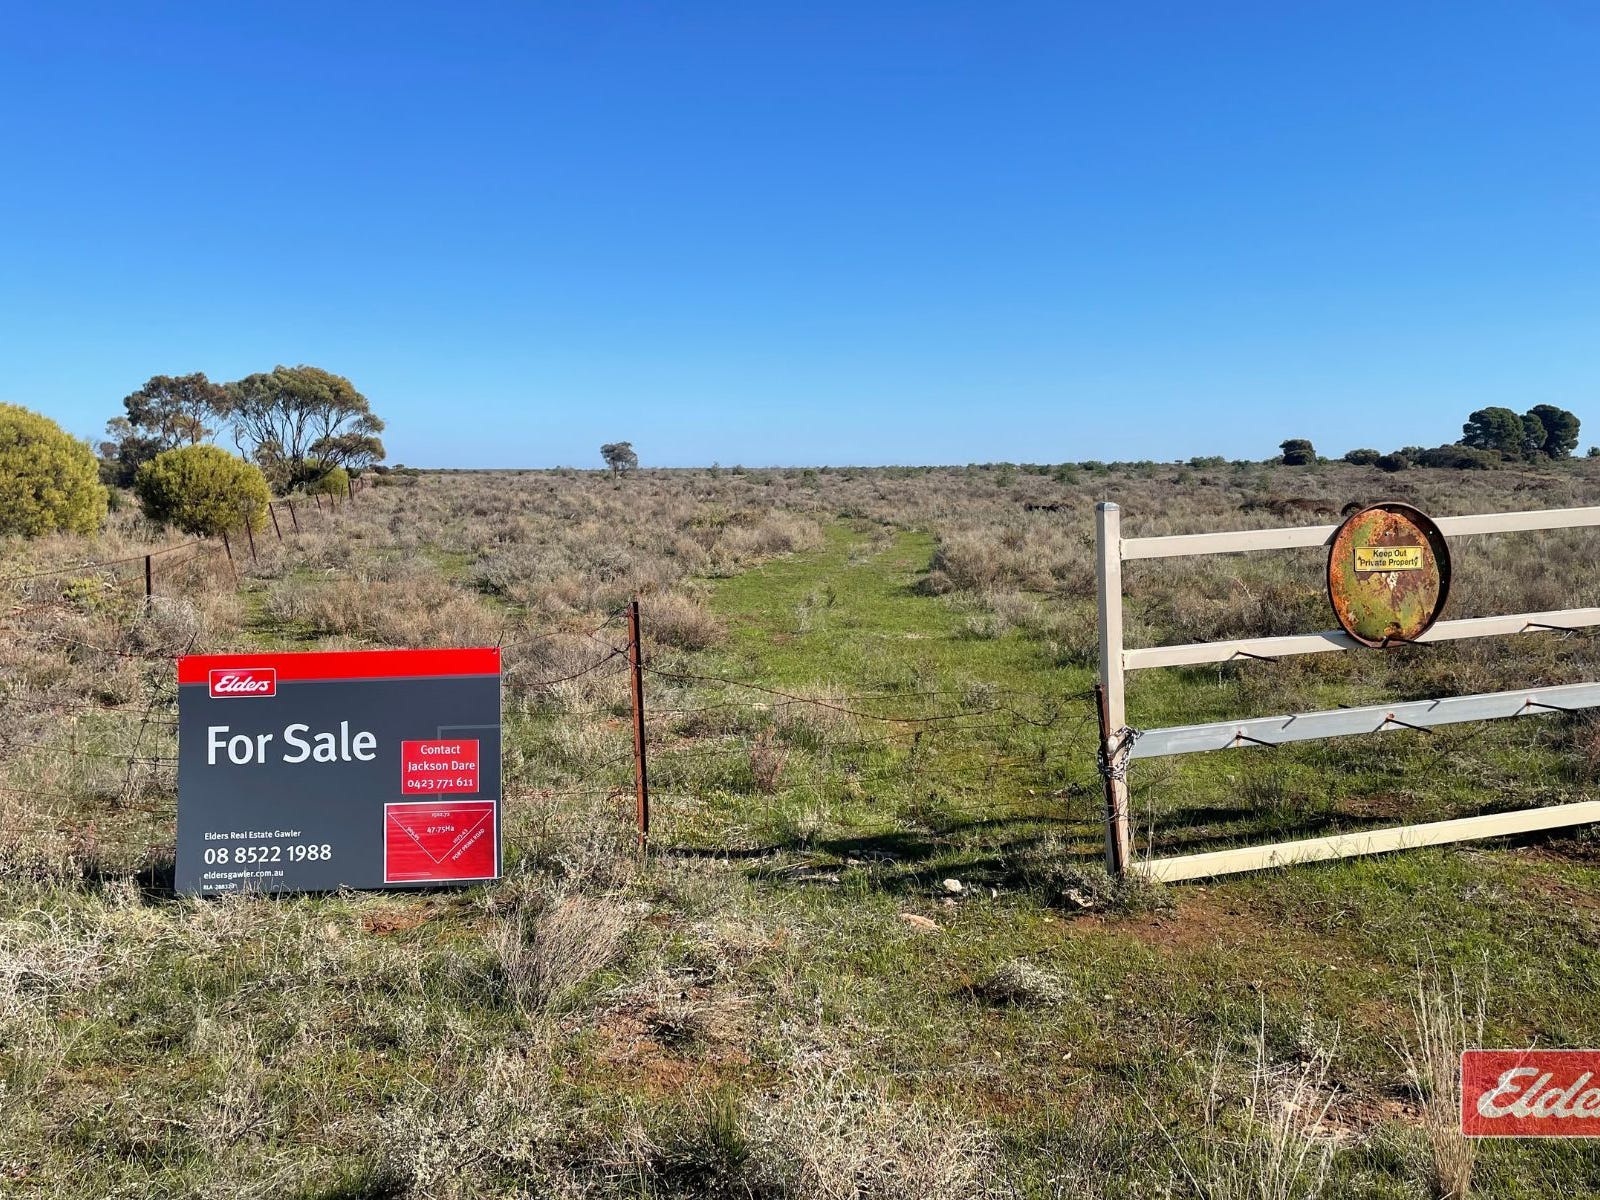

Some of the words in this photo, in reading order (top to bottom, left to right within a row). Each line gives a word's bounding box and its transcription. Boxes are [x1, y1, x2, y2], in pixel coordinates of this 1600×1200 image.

[1373, 549, 1393, 558] Keep
[1394, 549, 1407, 557] Out
[1360, 558, 1387, 567] Private
[1388, 557, 1419, 567] Property
[214, 675, 271, 693] Elders
[207, 725, 274, 765] For
[282, 720, 377, 764] Sale
[420, 744, 461, 755] Contact
[408, 761, 449, 773] Jackson
[451, 760, 476, 771] Dare
[407, 779, 434, 789] 0423
[436, 779, 453, 789] 771
[456, 777, 474, 787] 611
[204, 832, 229, 840] Elders
[230, 831, 248, 839] Real
[248, 831, 273, 839] Estate
[274, 829, 302, 838] Gawler
[204, 847, 229, 864] 08
[234, 846, 281, 864] 8522
[286, 844, 332, 862] 1988
[203, 869, 284, 880] eldersgawler.com.au
